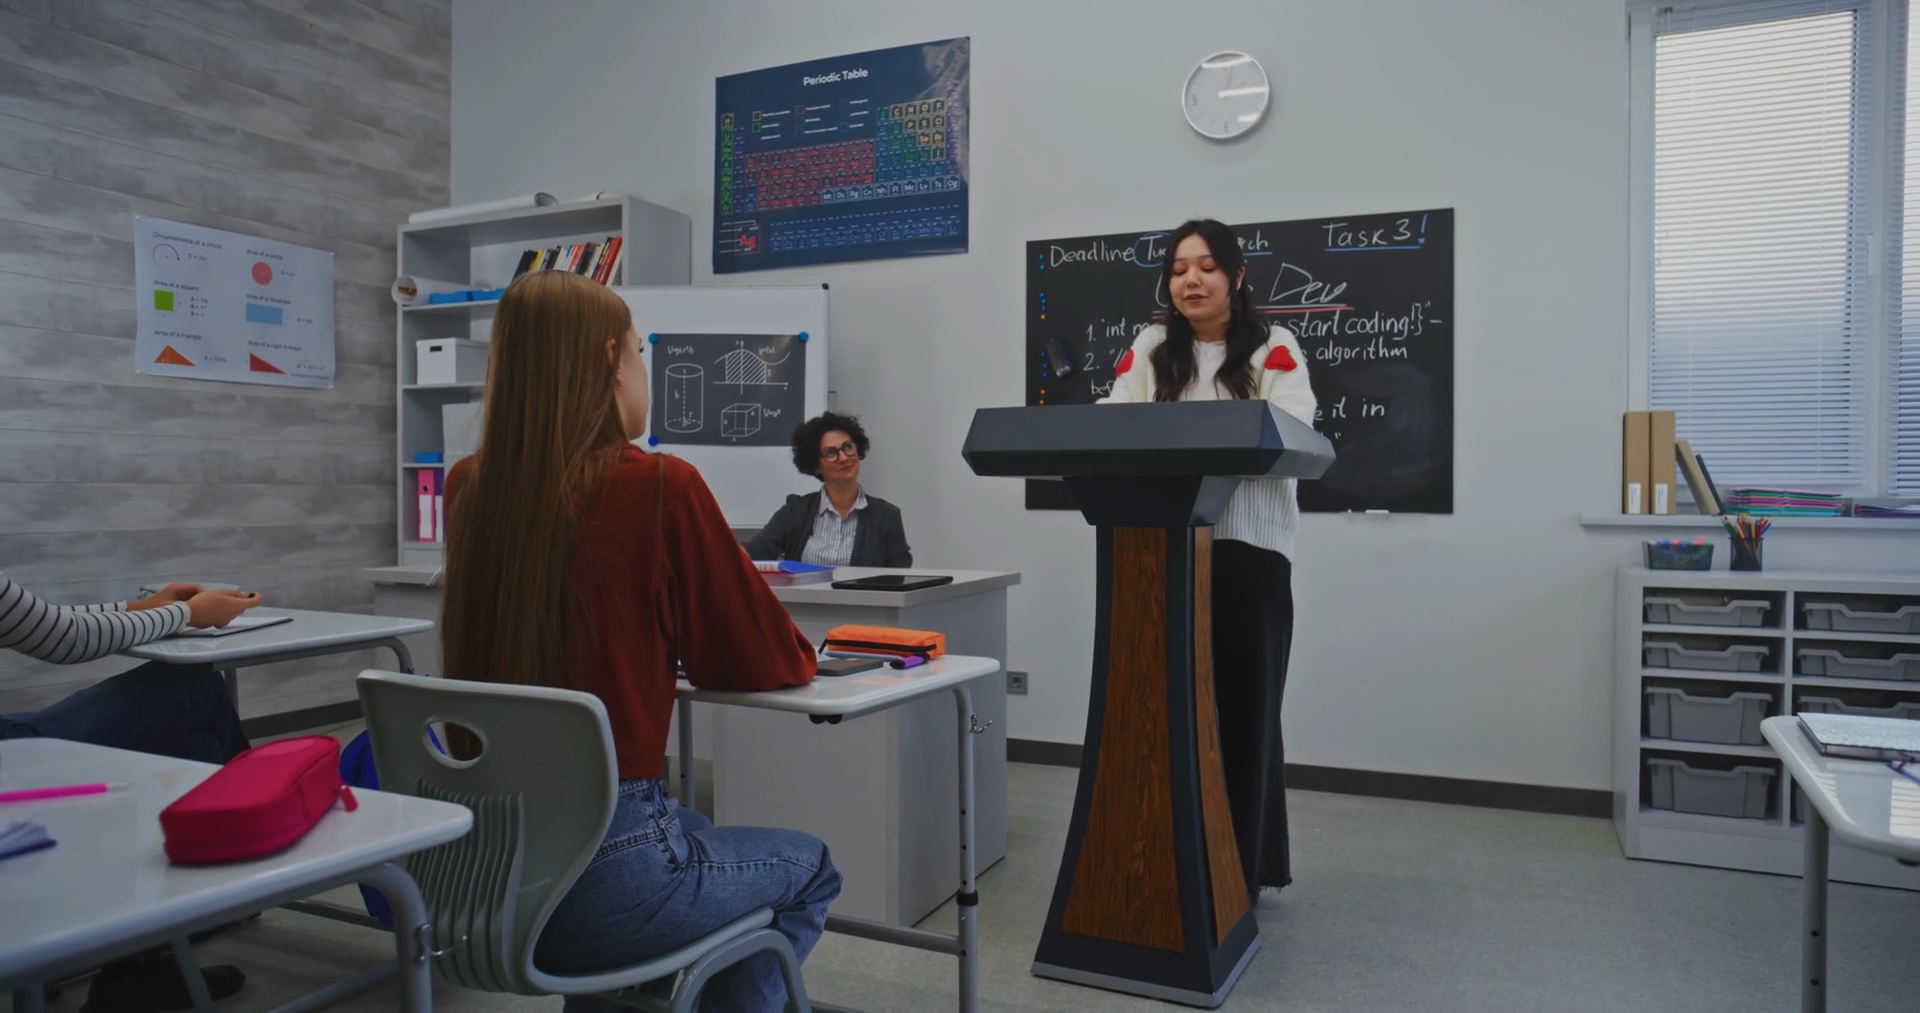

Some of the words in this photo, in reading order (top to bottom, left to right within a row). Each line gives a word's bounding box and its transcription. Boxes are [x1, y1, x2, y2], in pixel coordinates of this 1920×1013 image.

[803, 72, 842, 86] Periodic
[842, 68, 869, 80] Table
[739, 234, 756, 249] Ag
[1322, 222, 1388, 248] Task
[1050, 240, 1135, 268] Deadline
[1269, 262, 1348, 304] Dev
[1086, 324, 1096, 342] 1.
[1287, 309, 1340, 338] start
[1083, 352, 1100, 372] 2.
[1316, 336, 1408, 367] algorithm
[1332, 396, 1346, 418] it
[1362, 398, 1386, 418] in
